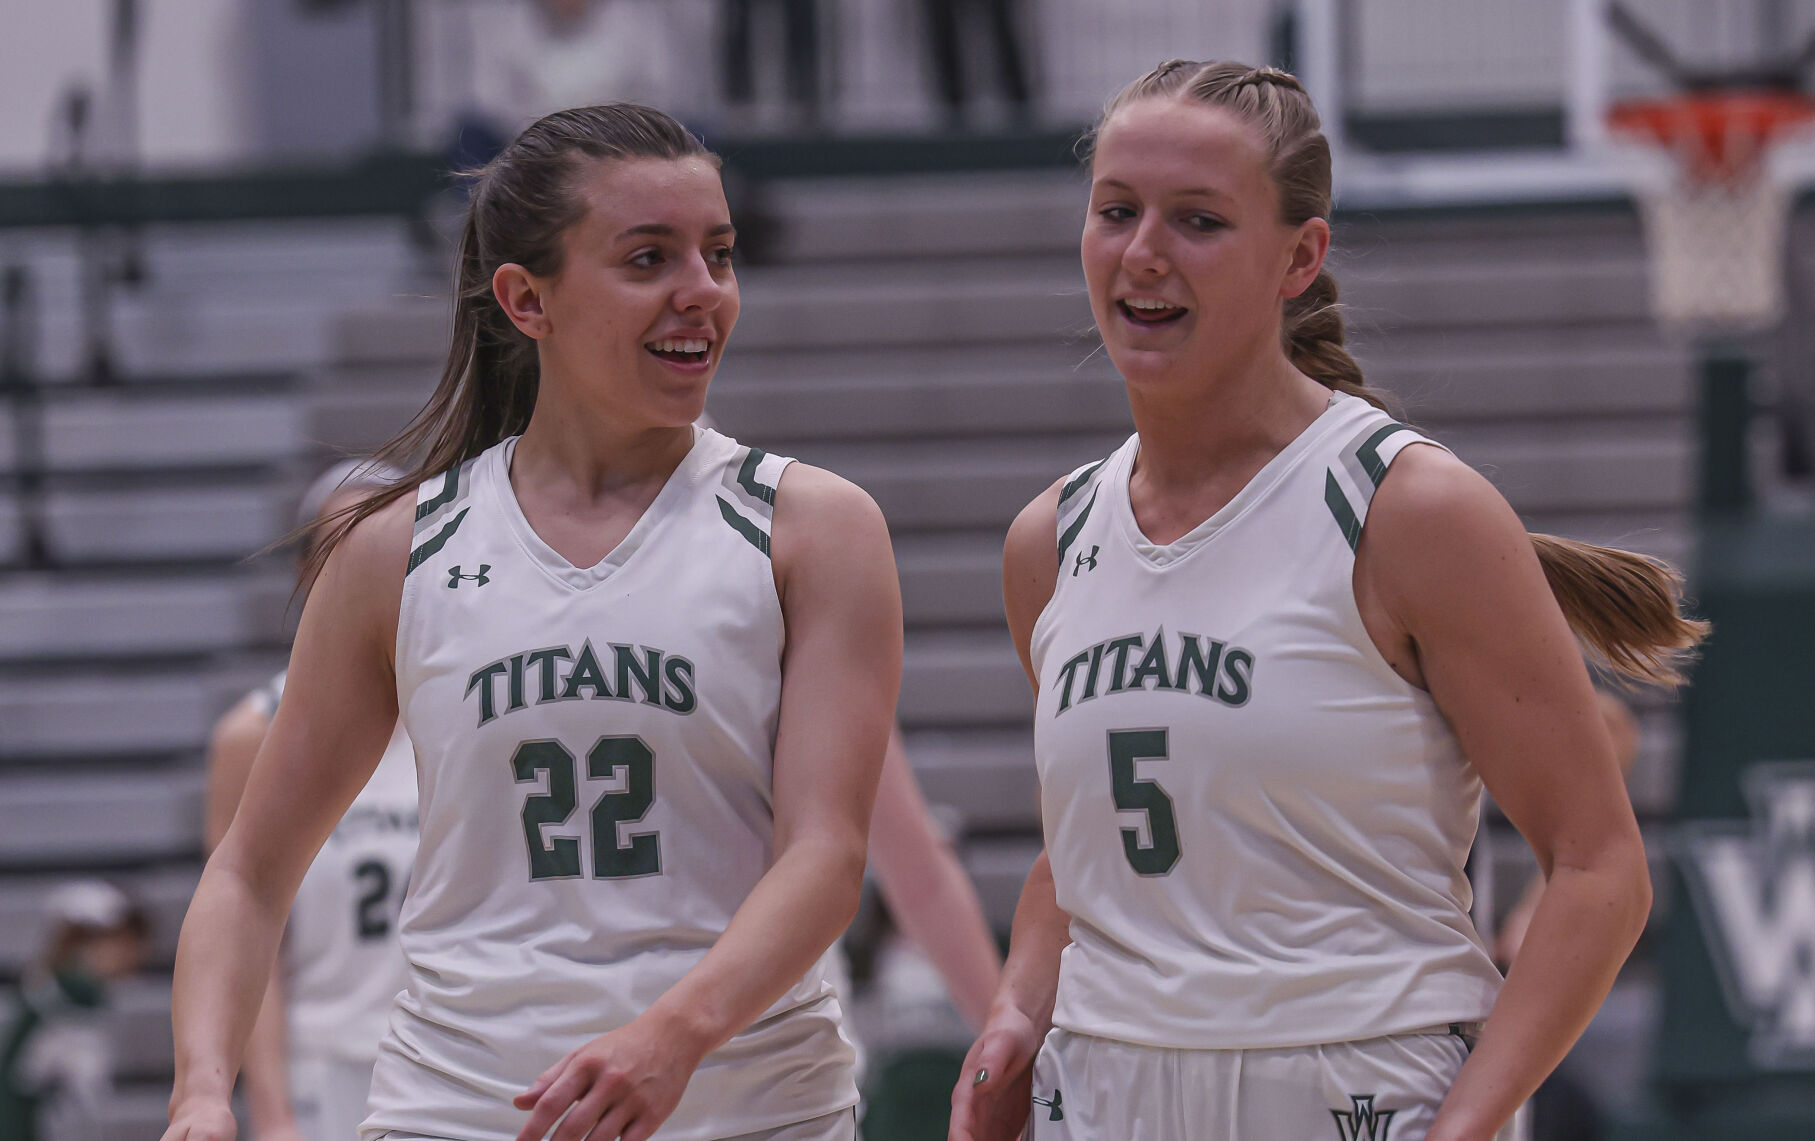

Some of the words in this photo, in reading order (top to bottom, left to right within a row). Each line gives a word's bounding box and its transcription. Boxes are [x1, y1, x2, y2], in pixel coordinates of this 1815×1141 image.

[463, 636, 698, 729] TITANS
[1053, 624, 1256, 719] TITANS
[509, 734, 663, 882] 22
[1106, 726, 1183, 878] 5
[351, 855, 412, 943] 2
